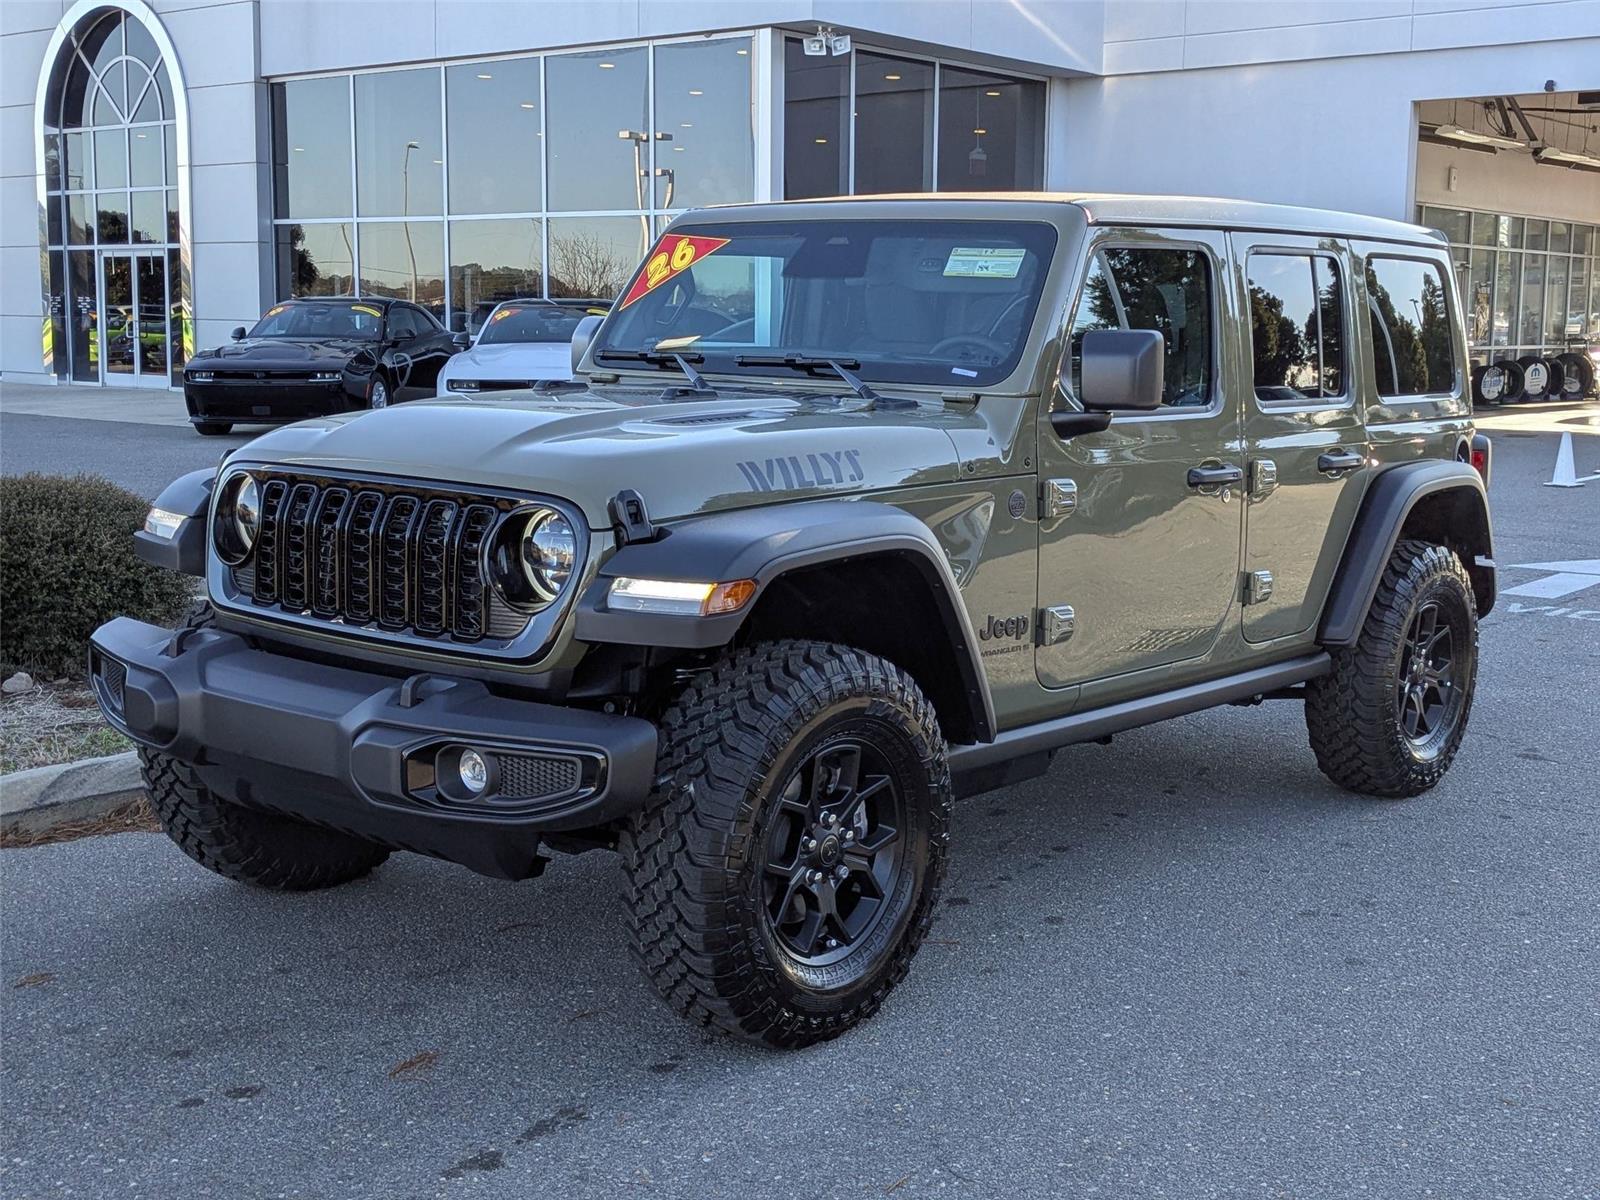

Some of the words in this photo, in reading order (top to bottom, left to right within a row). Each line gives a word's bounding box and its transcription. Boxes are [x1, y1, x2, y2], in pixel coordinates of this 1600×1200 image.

[646, 237, 696, 289] 26
[736, 449, 864, 492] WILLYS
[979, 614, 1029, 641] Jeep
[980, 645, 1022, 658] WRANGLER
